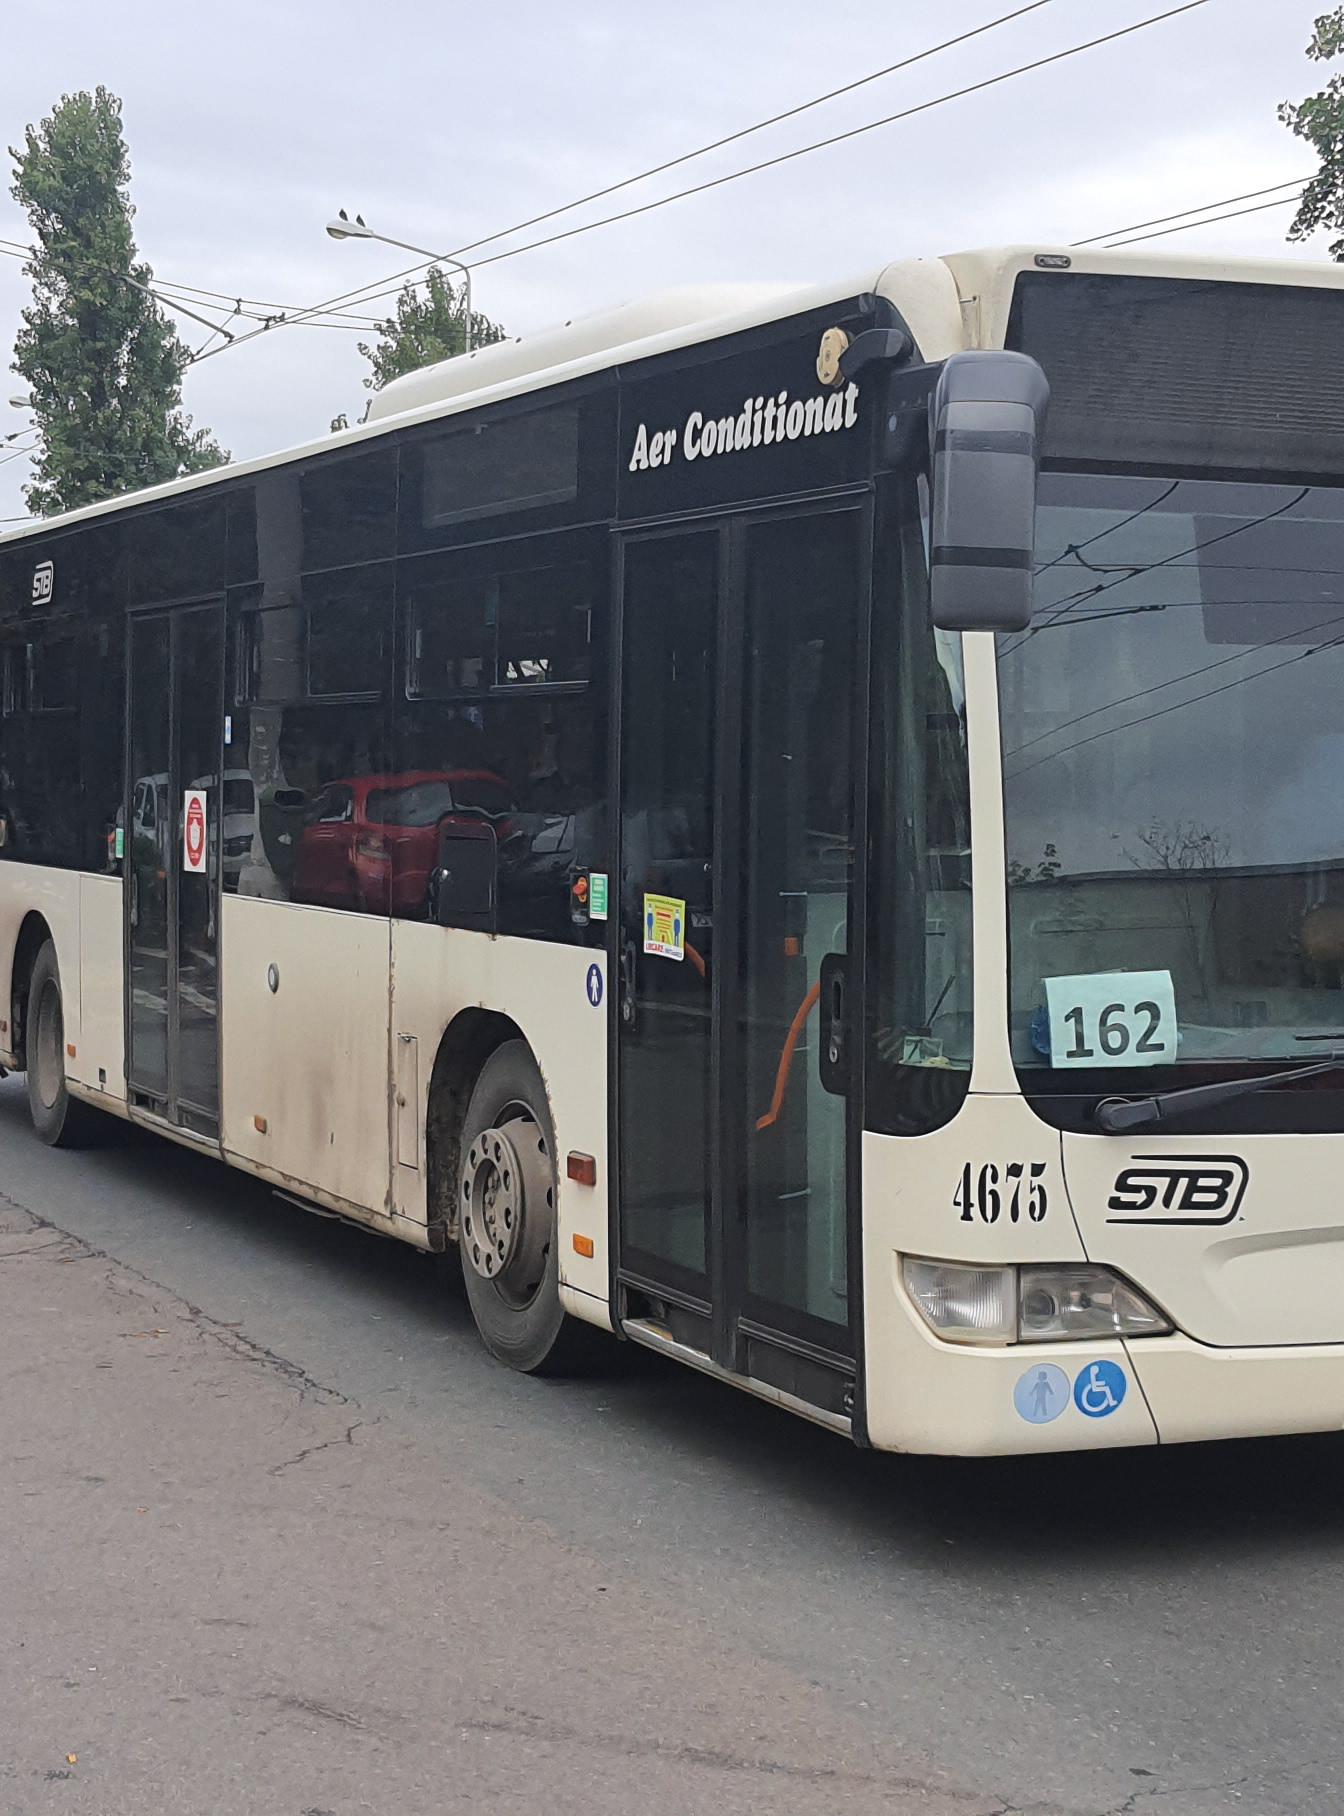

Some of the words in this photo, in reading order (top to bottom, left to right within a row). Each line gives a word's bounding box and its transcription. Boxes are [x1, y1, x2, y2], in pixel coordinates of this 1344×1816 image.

[629, 423, 677, 472] Aer
[683, 381, 859, 461] Conditionat
[32, 569, 52, 598] STB
[1064, 1000, 1165, 1059] 162
[953, 1161, 1048, 1224] 4675
[1107, 1167, 1235, 1211] STB
